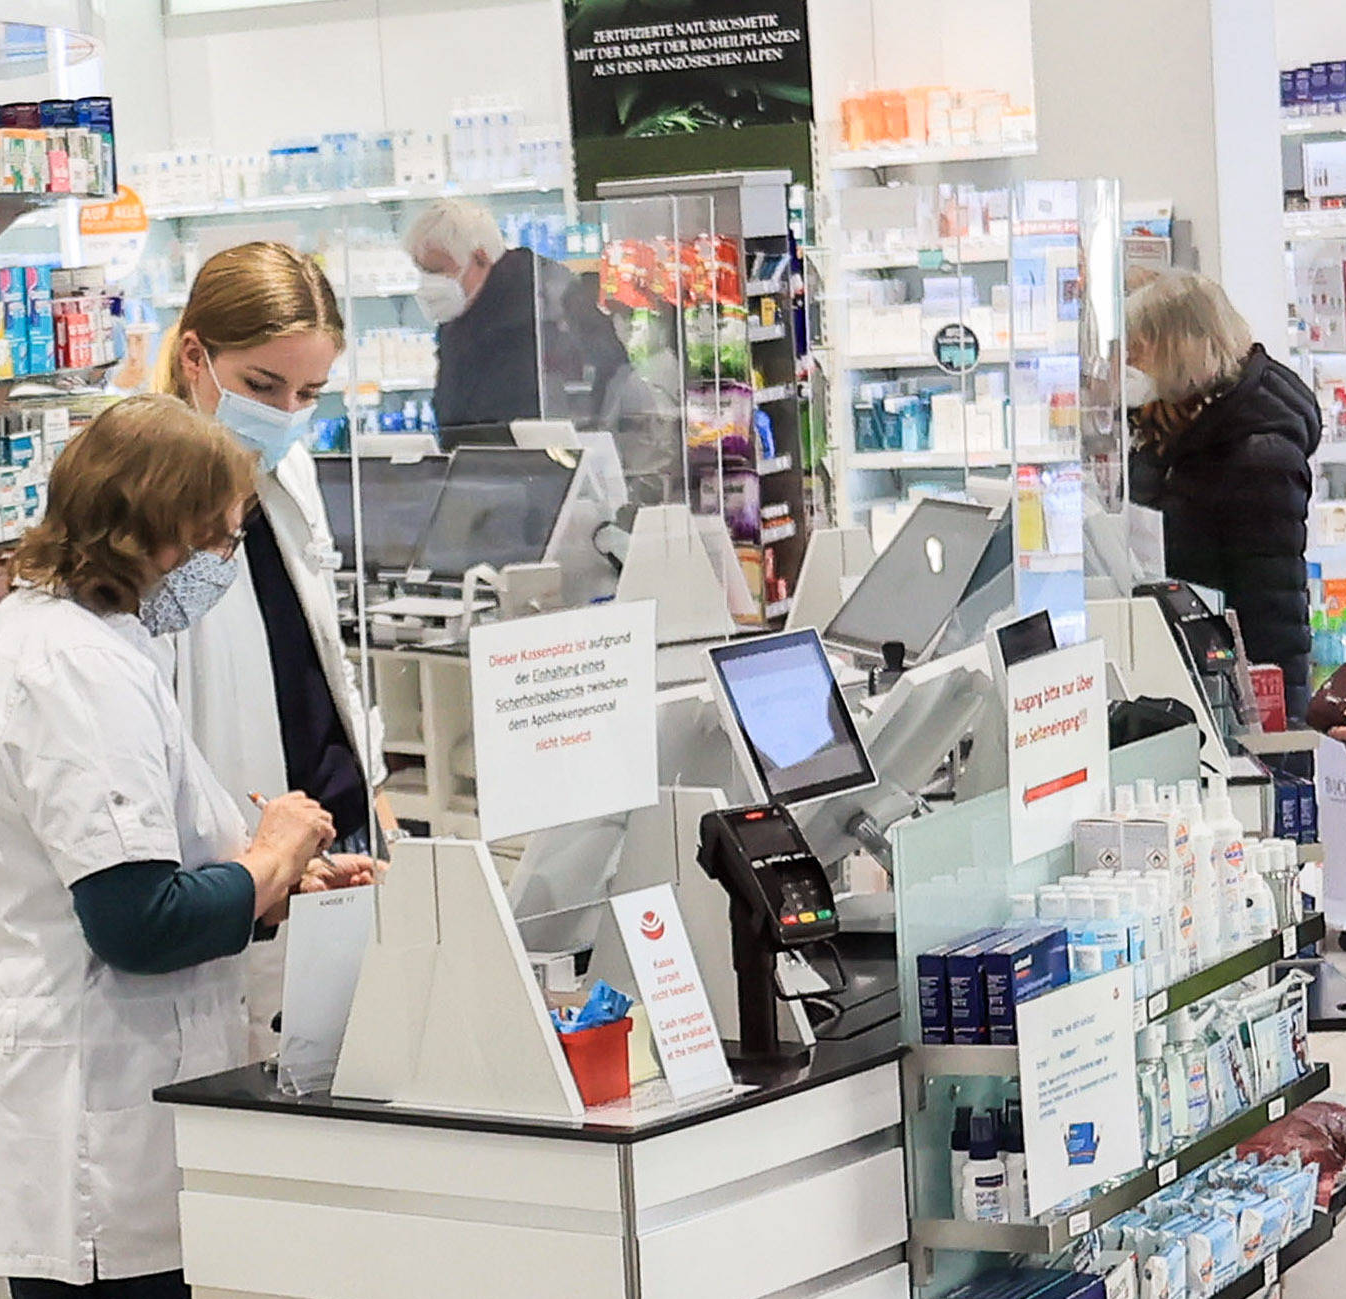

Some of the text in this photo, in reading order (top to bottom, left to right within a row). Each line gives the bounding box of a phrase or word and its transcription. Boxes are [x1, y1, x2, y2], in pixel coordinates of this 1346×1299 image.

[593, 14, 778, 43] ZERTIFIZIERTE NATURKOSMETIK
[572, 29, 801, 62] MIT DER KRAFT DER BIO-HEILPFLANZEN
[593, 48, 783, 77] AUS DEN FRANZÖSISCHEN ALPEN
[489, 632, 631, 667] Dieser Kassenplatz ist aufgrund
[515, 660, 605, 685] der Einhaltung eines
[587, 677, 628, 694] zwischen
[1044, 686, 1060, 702] bitte
[1062, 682, 1074, 696] nur
[1077, 675, 1093, 691] über
[509, 699, 616, 731] dem Apothekenpersonal
[536, 730, 591, 752] nicht besetzt
[1015, 732, 1027, 748] den
